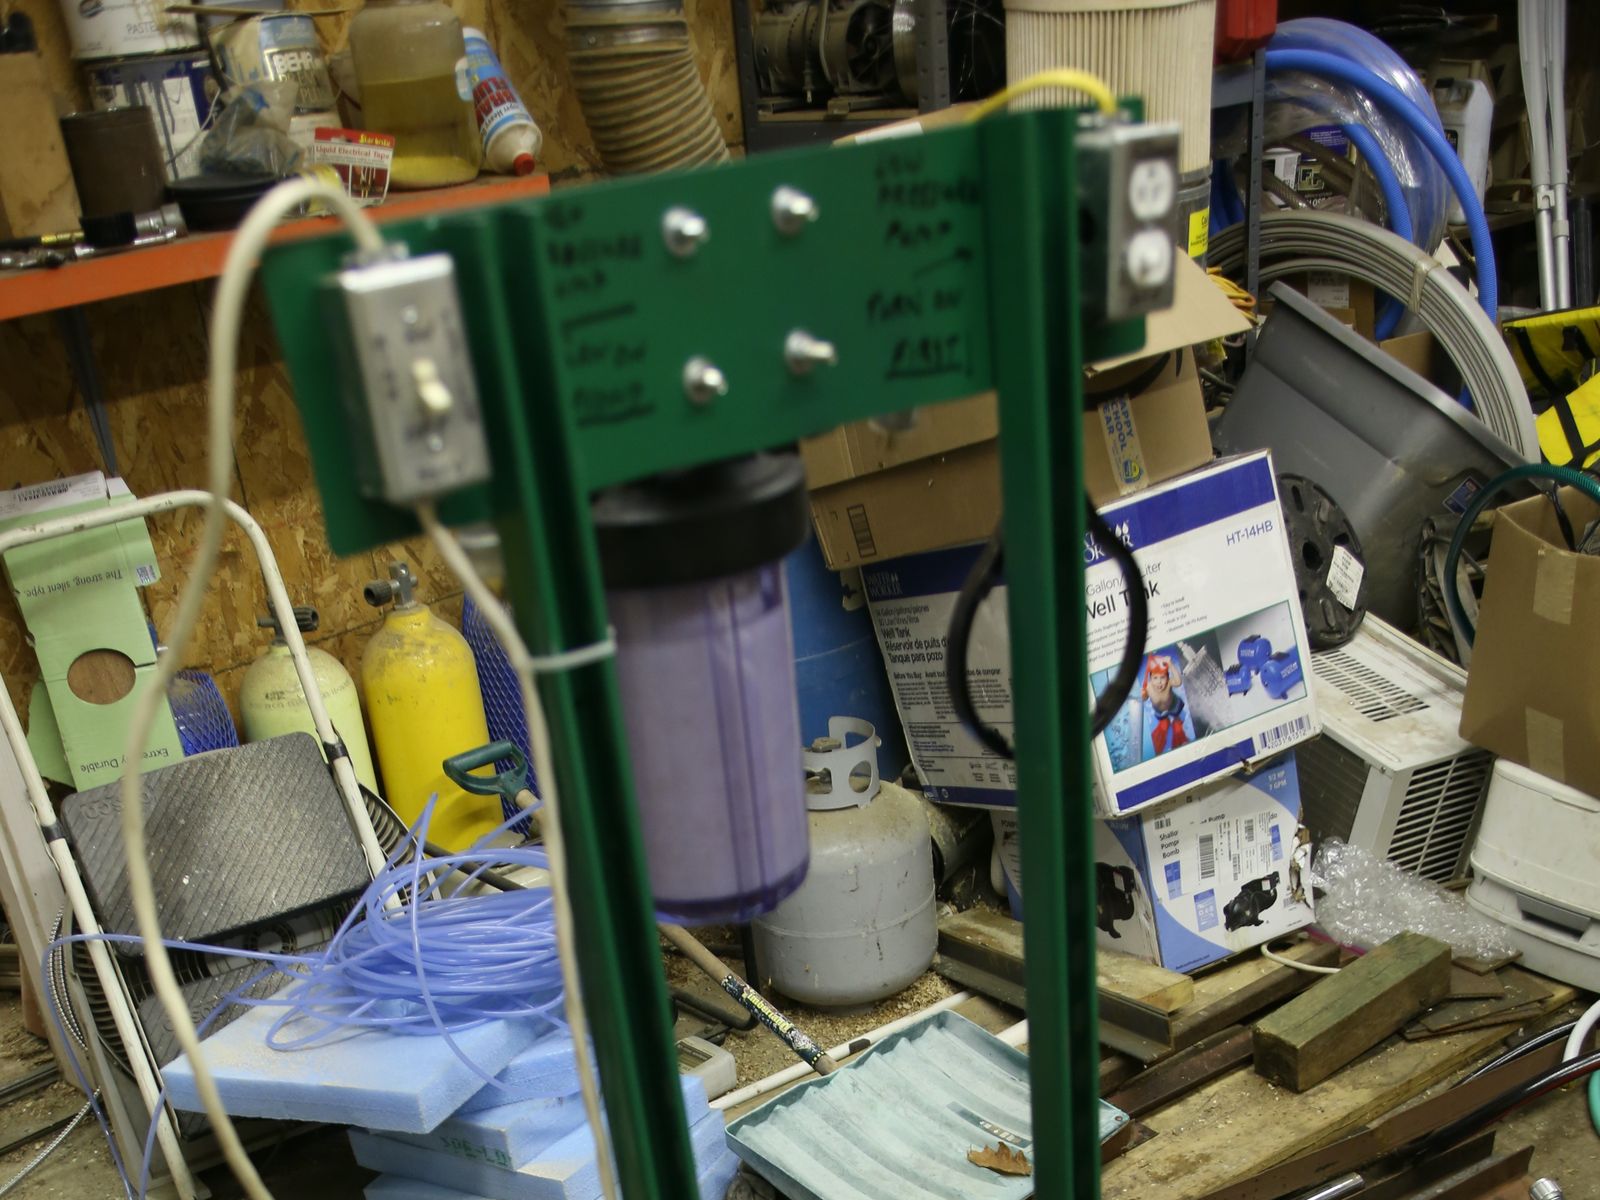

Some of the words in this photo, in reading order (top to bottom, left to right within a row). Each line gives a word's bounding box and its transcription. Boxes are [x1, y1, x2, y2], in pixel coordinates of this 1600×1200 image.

[272, 51, 314, 74] BEHR
[316, 145, 337, 154] Liquid
[338, 146, 371, 158] Electrical
[373, 151, 390, 160] Tape
[1226, 519, 1274, 547] HT-14HB
[73, 574, 104, 587] strong,
[106, 568, 123, 580] The
[23, 587, 43, 600] type.
[47, 580, 72, 595] silent
[882, 628, 895, 639] Well
[895, 627, 911, 638] Tank
[924, 638, 942, 651] puits
[888, 653, 911, 665] Tanque
[912, 652, 926, 664] para
[927, 651, 944, 662] pozo
[80, 757, 120, 774] Durable
